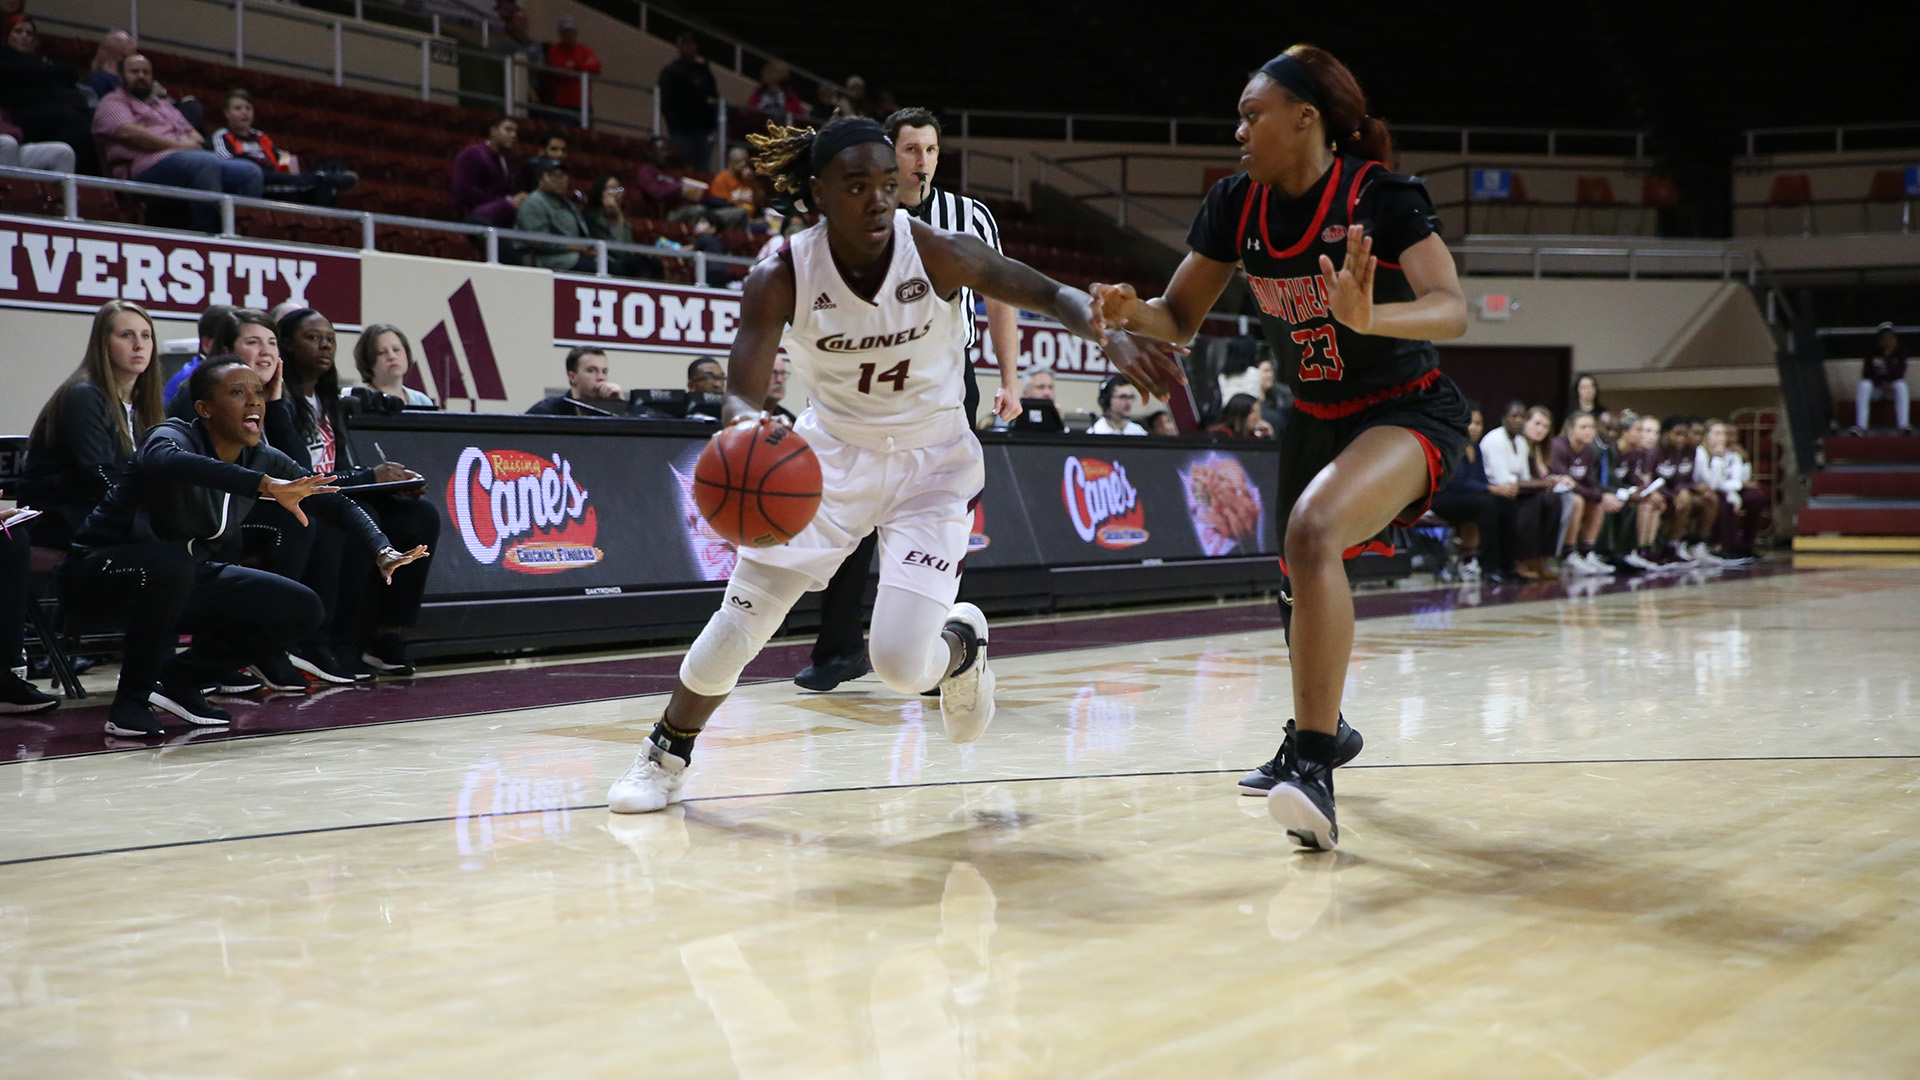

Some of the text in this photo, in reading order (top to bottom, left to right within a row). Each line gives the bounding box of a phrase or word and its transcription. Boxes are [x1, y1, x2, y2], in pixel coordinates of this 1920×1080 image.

[575, 287, 741, 344] HOME
[812, 303, 837, 311] adidas
[816, 319, 933, 353] COLONELS
[1291, 324, 1344, 381] 23
[858, 359, 911, 394] 14
[454, 446, 588, 564] Cane's
[904, 550, 950, 572] EKU
